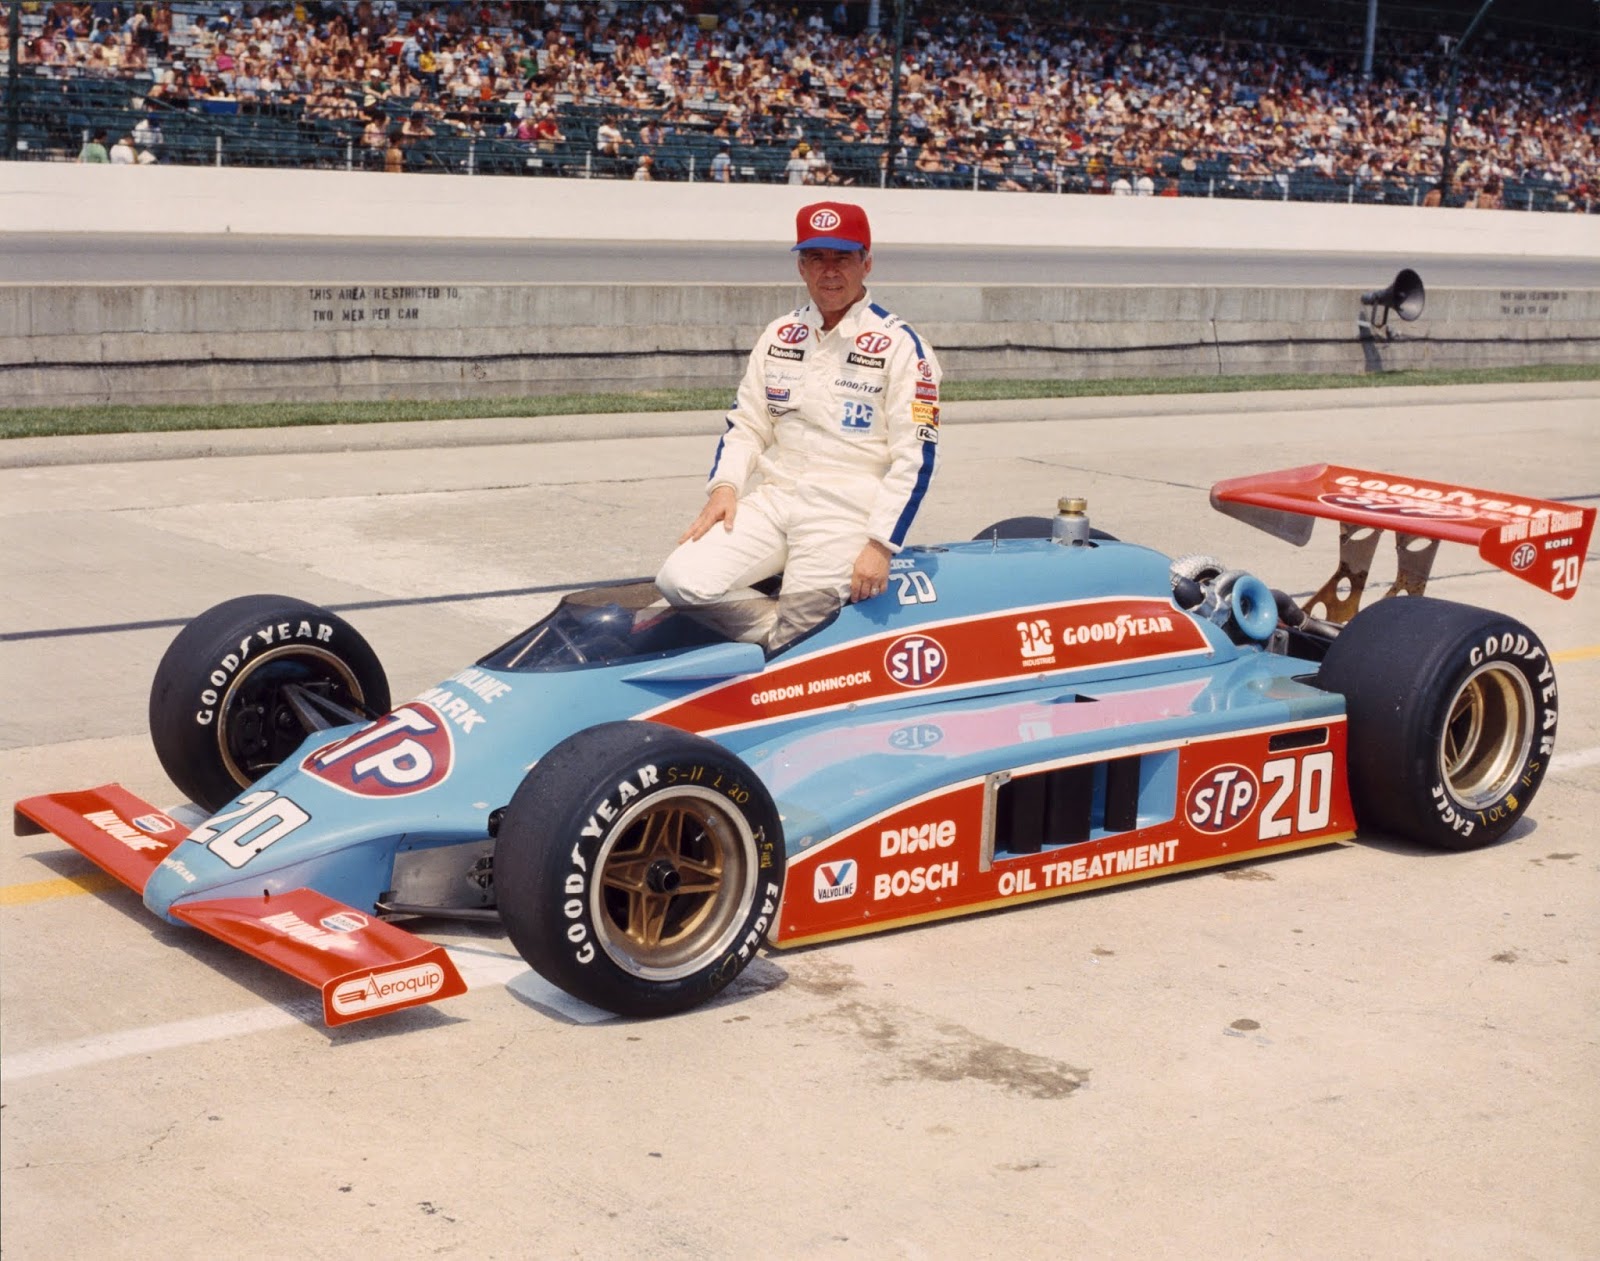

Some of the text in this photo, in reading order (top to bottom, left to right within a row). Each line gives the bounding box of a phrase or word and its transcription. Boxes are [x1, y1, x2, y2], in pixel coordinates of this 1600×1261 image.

[813, 212, 837, 228] STP
[309, 288, 332, 301] THIS
[338, 286, 366, 301] AREA
[313, 309, 333, 322] TWO
[398, 307, 419, 320] CAR
[778, 324, 808, 342] STP
[857, 333, 889, 352] STP
[769, 346, 802, 359] Valvoline
[1334, 475, 1565, 519] GOODYEAR
[1513, 545, 1536, 570] STP
[1545, 536, 1573, 550] KONI
[888, 571, 938, 606] 20
[1552, 555, 1580, 593] 20
[1063, 613, 1173, 645] GOODYEAR
[196, 620, 334, 726] GOODYEAR
[892, 639, 942, 682] STP
[1022, 656, 1056, 667] INDUSTRIES
[751, 671, 872, 706] GORDON JOHNCOCK
[1469, 632, 1558, 756] GOODYEAR
[727, 783, 750, 804] 20
[1191, 770, 1253, 827] STP
[1258, 751, 1334, 841] 20
[1431, 783, 1476, 838] EAGLE
[187, 790, 312, 869] 20
[563, 764, 660, 965] GOODYEAR
[873, 861, 959, 901] BOSCH
[998, 839, 1179, 896] OIL TREATMENT
[818, 882, 854, 900] VALVOLINE
[737, 881, 779, 962] EAGLE
[363, 972, 440, 1001] Aeroquip
